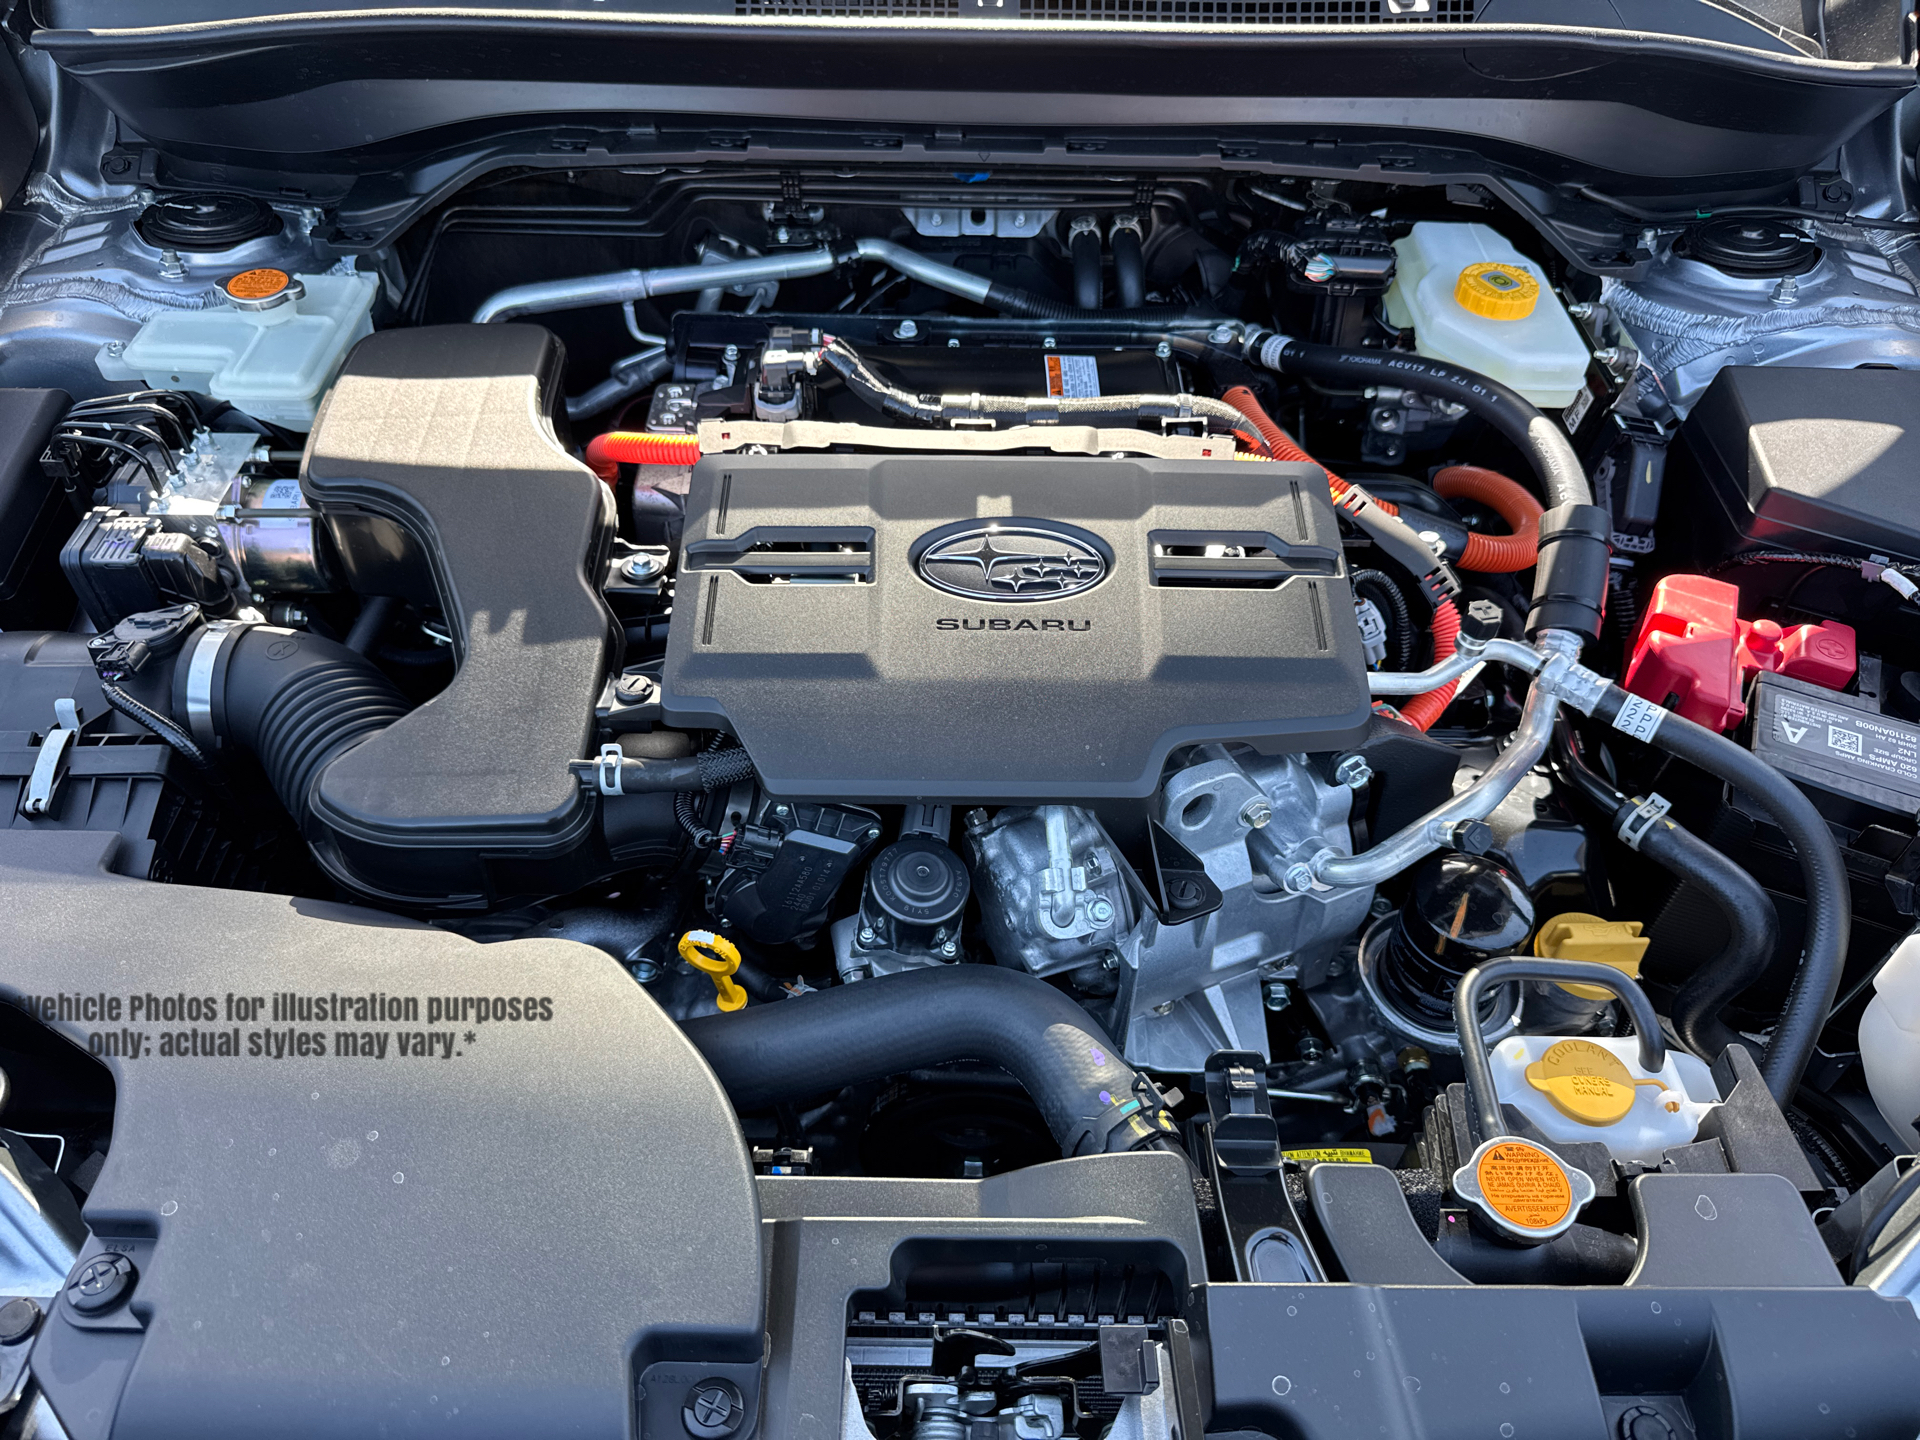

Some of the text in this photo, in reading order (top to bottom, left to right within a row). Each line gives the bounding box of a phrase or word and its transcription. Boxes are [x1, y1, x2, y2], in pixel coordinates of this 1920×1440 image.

[1388, 360, 1425, 372] ACV17
[1430, 368, 1446, 378] LP
[1451, 375, 1467, 386] ZJ
[1408, 515, 1447, 532] SUBARU
[935, 618, 1091, 632] SUBARU
[1856, 719, 1916, 743] 82110AN00B
[1876, 733, 1885, 741] AH
[1874, 747, 1916, 765] GROUP SIZE
[1898, 747, 1916, 758] LN2
[1835, 750, 1917, 779] COLD CRANKING AMPS
[1869, 753, 1917, 773] 620 AMPS
[1547, 1041, 1620, 1067] COOLANT
[1574, 1067, 1593, 1075] SEE
[1571, 1076, 1611, 1087] OWNERS
[1574, 1087, 1614, 1097] MANUAL
[105, 1244, 136, 1253] ELSA
